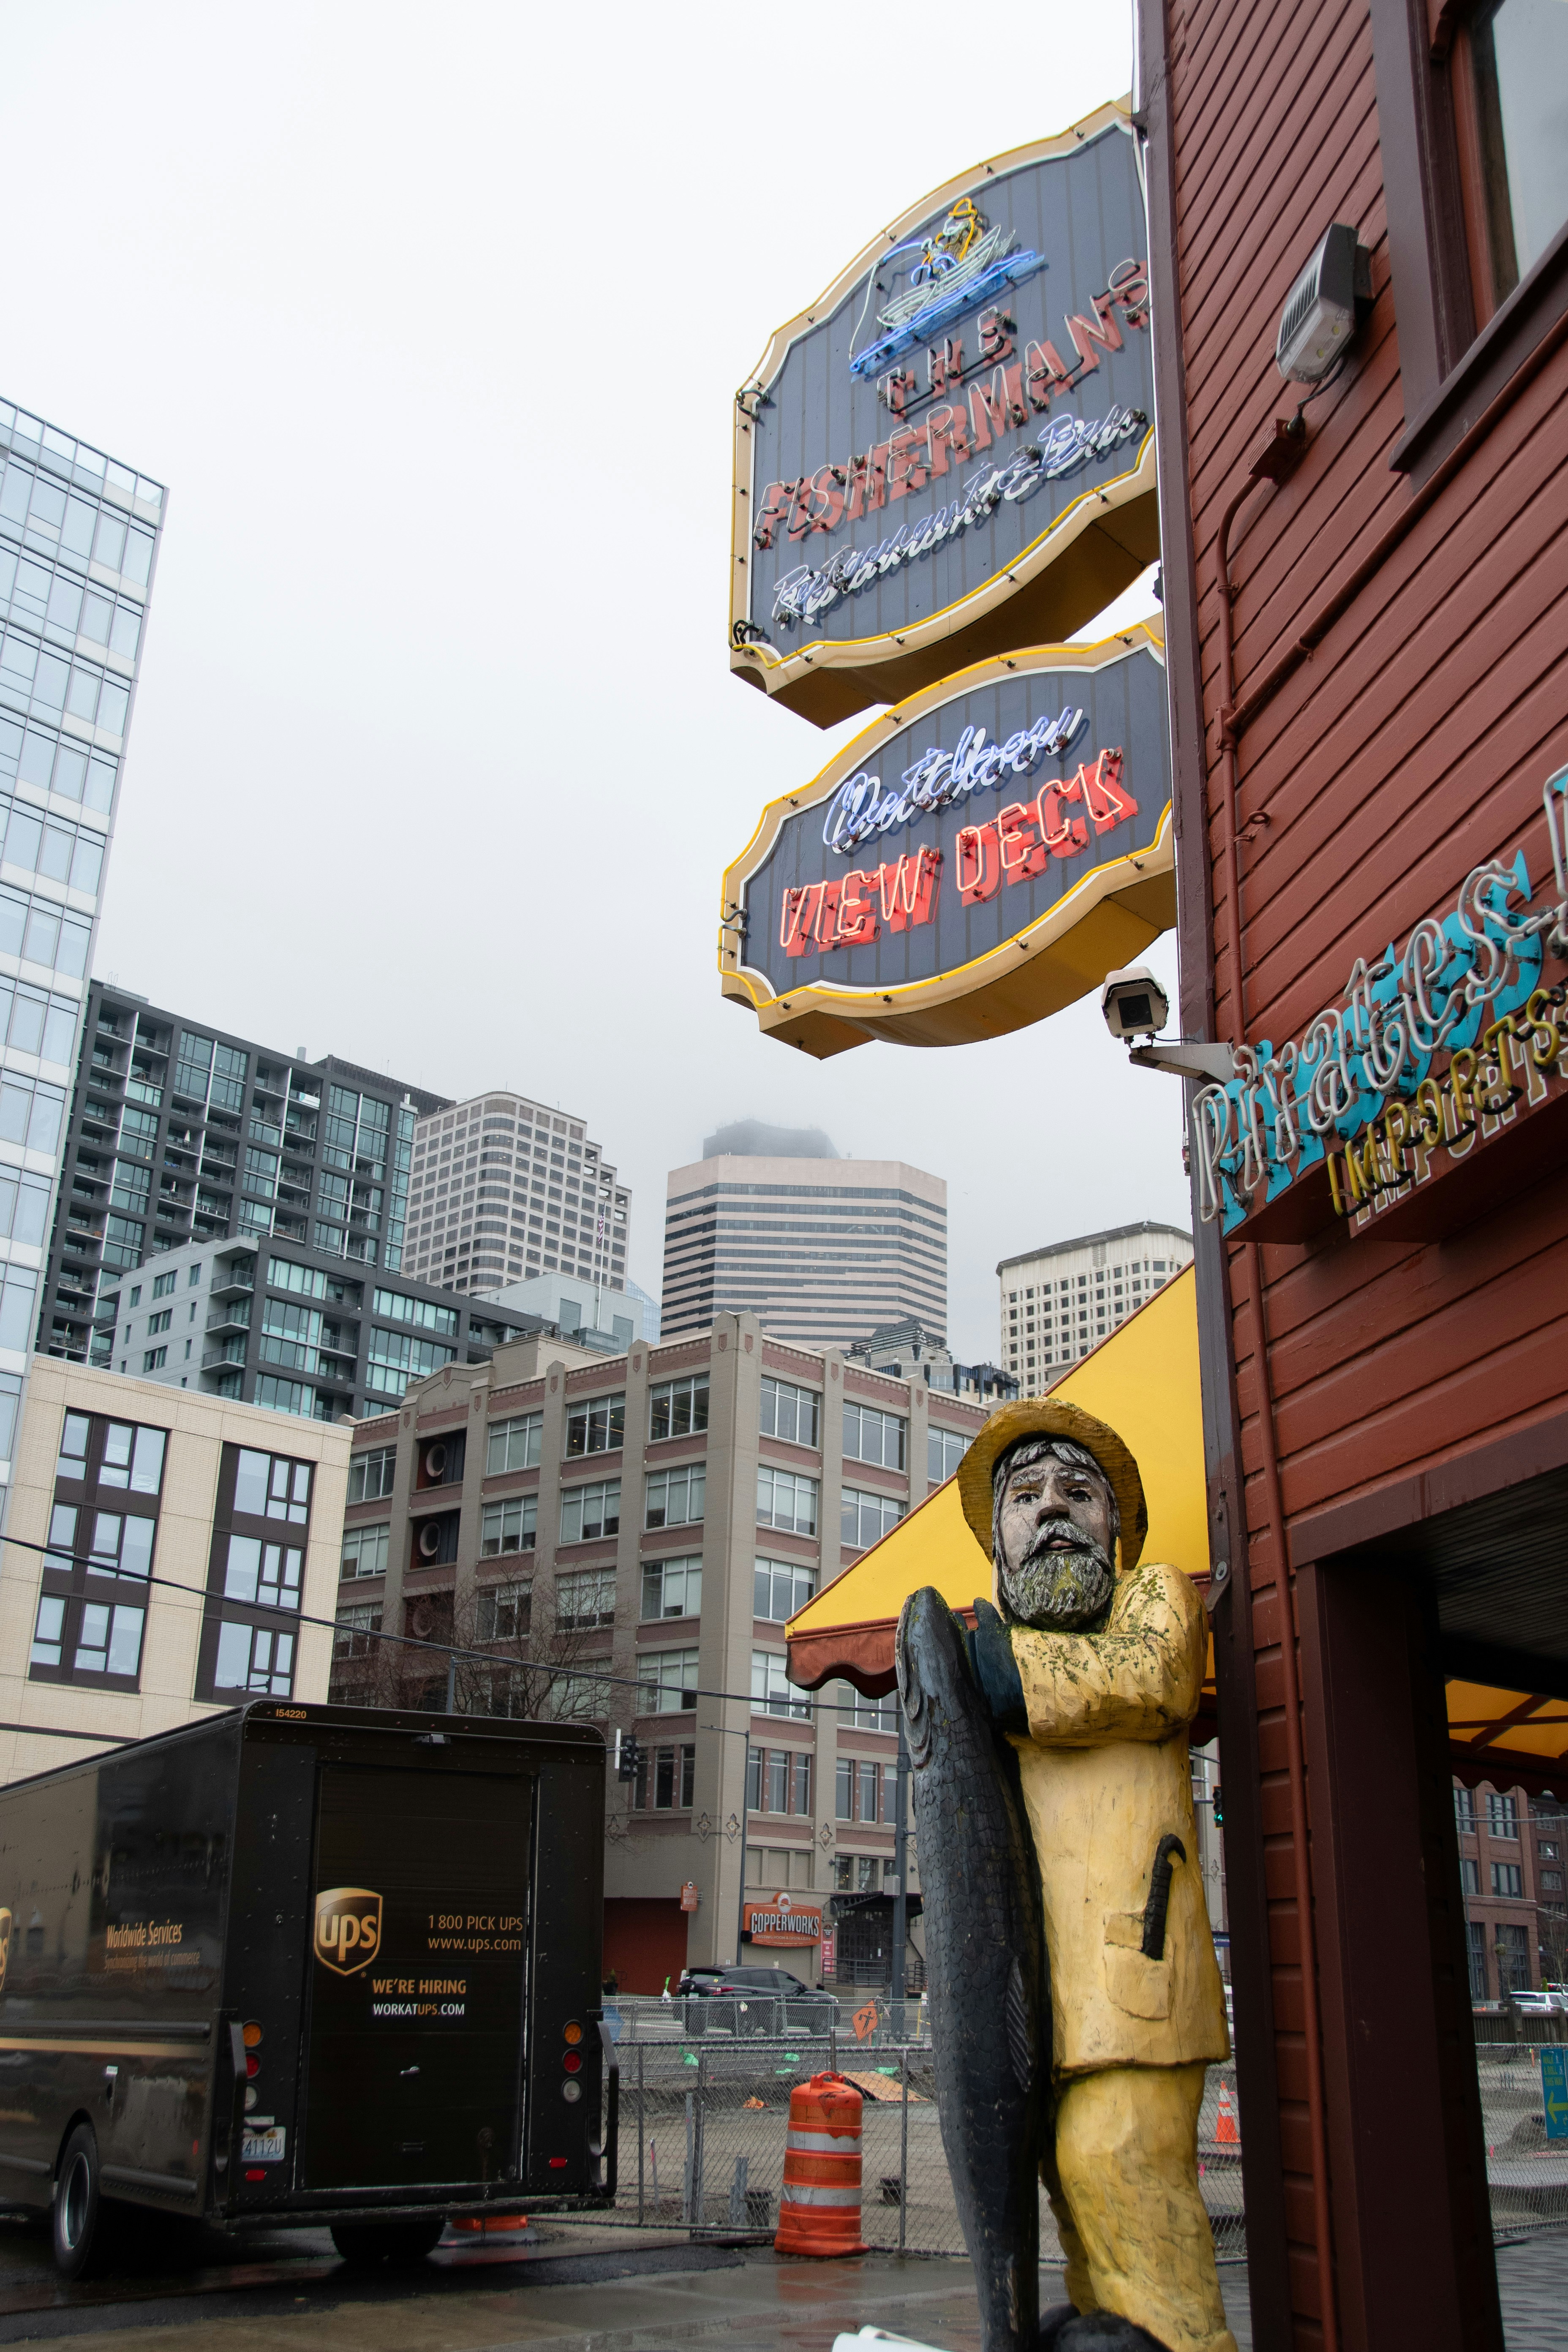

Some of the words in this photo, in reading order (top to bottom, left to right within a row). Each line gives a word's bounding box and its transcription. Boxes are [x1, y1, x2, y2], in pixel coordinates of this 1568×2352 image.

[878, 307, 1014, 420] THE
[772, 462, 1006, 630] Restaurant
[1037, 405, 1141, 478] Bar
[823, 707, 1082, 854] Outdoor
[781, 847, 939, 957] VIEW
[956, 746, 1138, 906] DECK
[1327, 988, 1568, 1226] IMPORTS
[107, 1922, 147, 1948] Worldwide
[147, 1918, 183, 1946] Services
[429, 1915, 434, 1929] 1
[438, 1915, 463, 1929] 800
[467, 1916, 495, 1930] PICK
[500, 1916, 523, 1931] UPS
[751, 1912, 819, 1937] COPPERWORKS
[319, 1914, 376, 1961] ups
[428, 1938, 521, 1953] www.ups.com
[171, 1952, 200, 1965] commerce
[373, 1978, 415, 1994] WE'RE
[419, 1980, 466, 1994] HIRING
[373, 2004, 465, 2015] WORKATUPS.COM
[243, 2139, 282, 2155] 4112U
